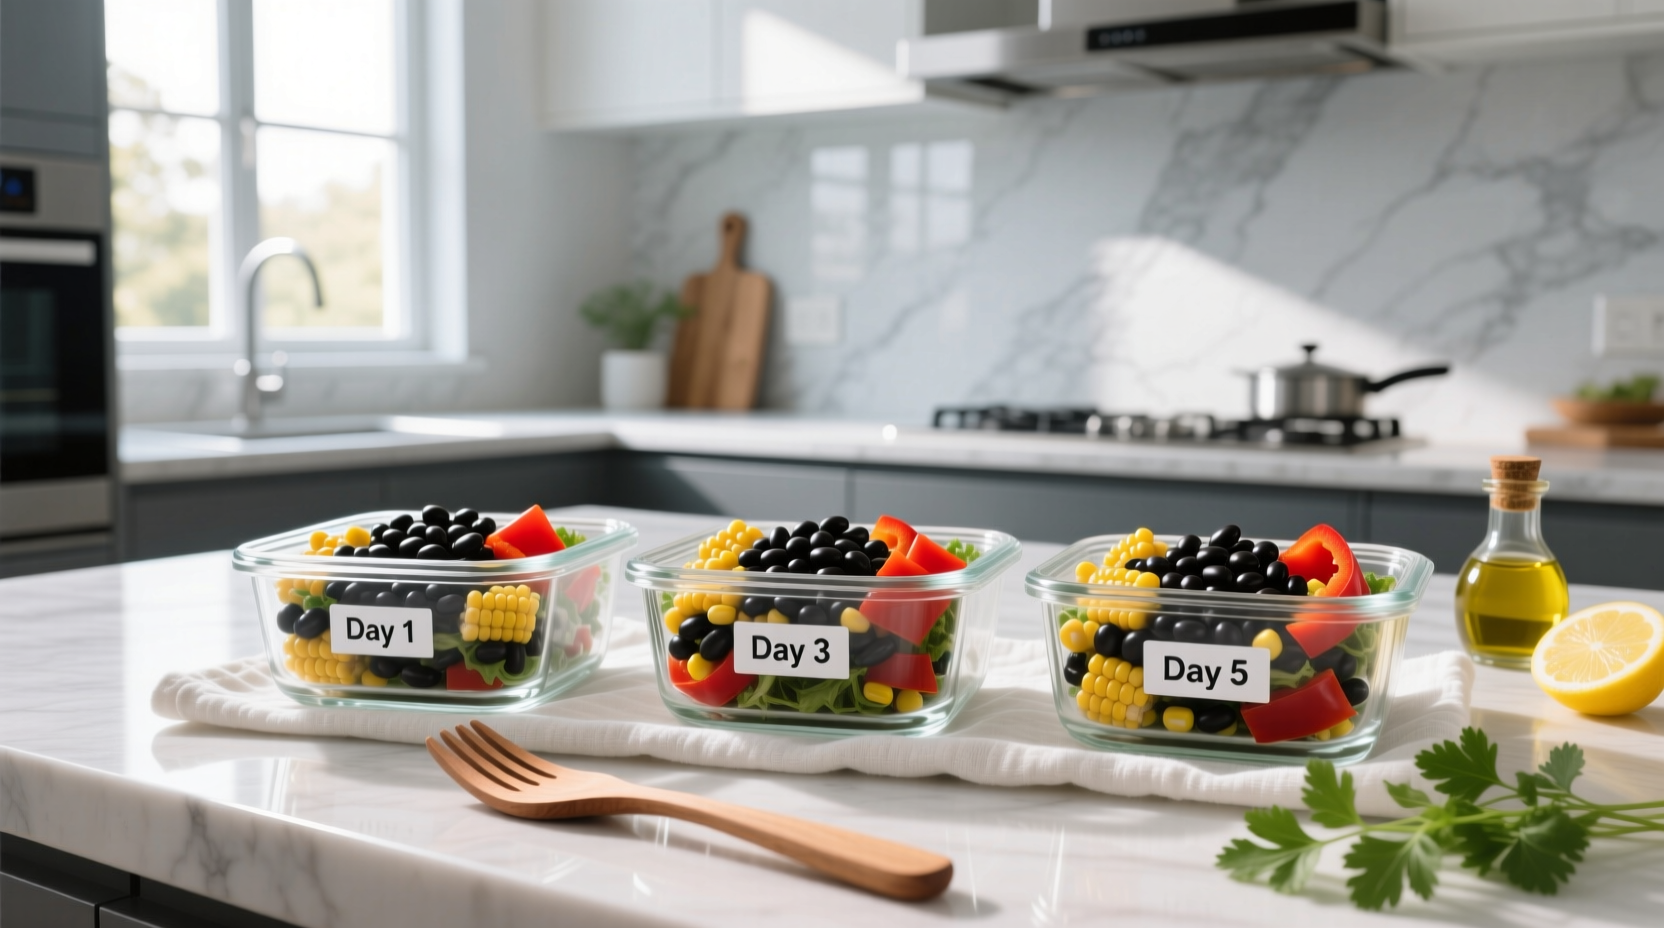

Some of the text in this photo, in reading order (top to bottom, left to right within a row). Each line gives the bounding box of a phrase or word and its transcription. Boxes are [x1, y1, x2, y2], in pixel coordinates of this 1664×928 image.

[346, 616, 414, 649] Day 1
[751, 634, 831, 669] Day 3
[1163, 655, 1249, 691] Day 5
